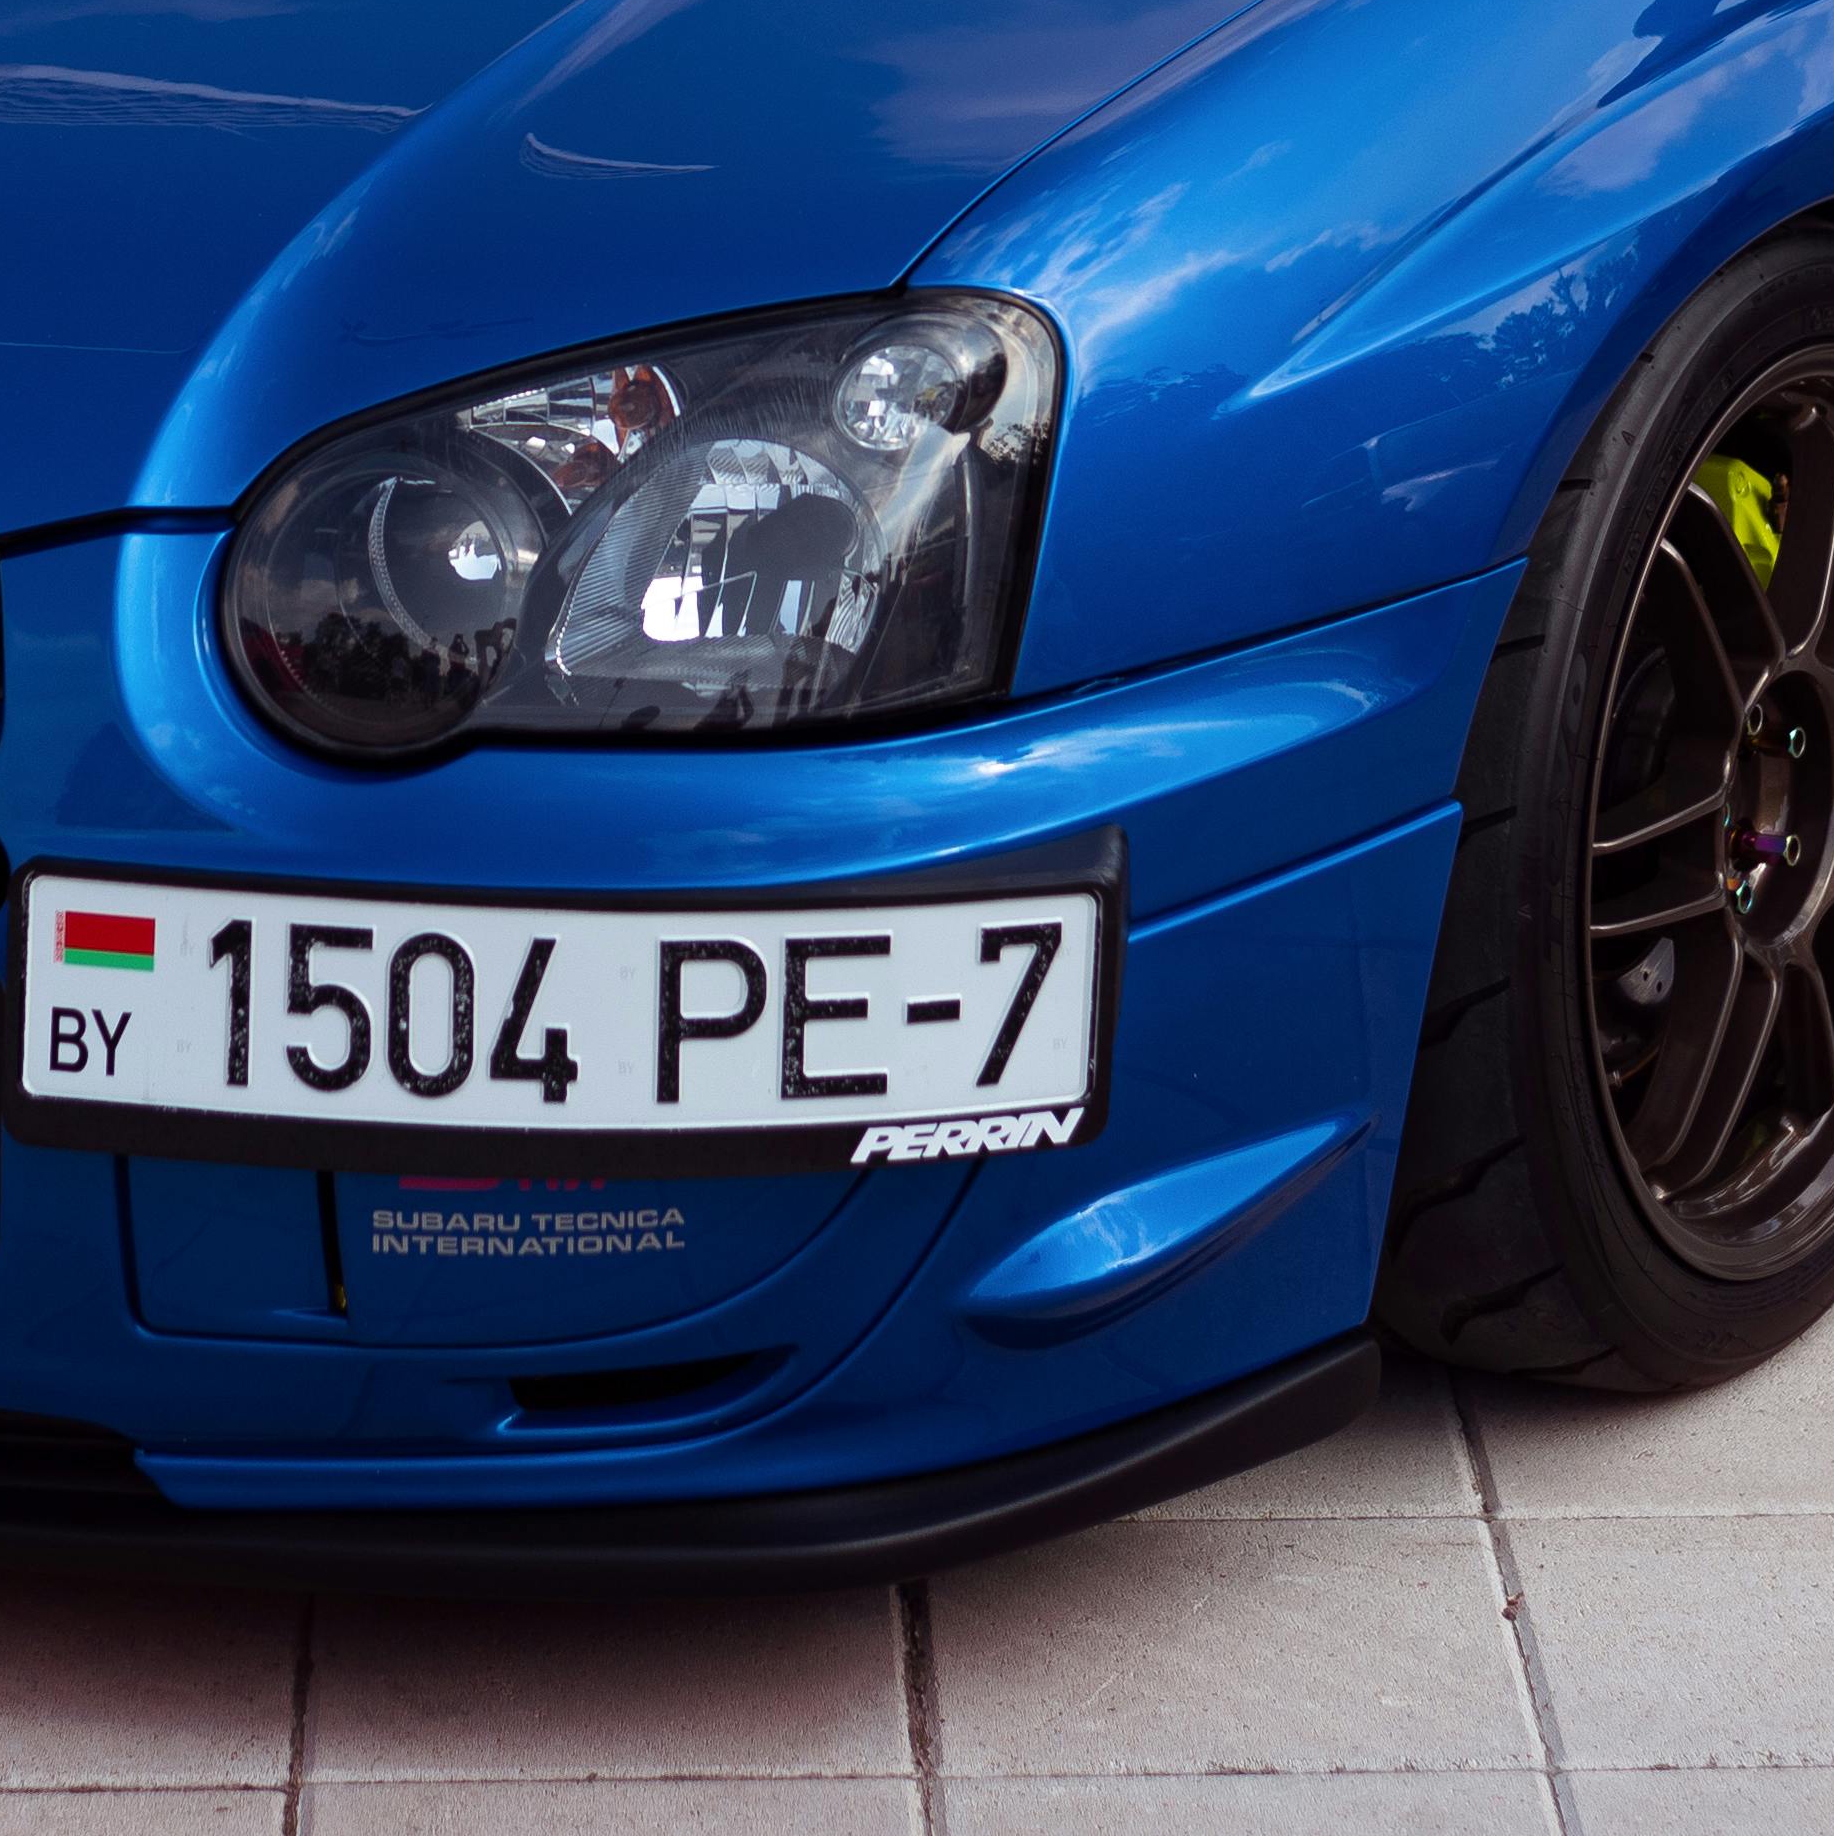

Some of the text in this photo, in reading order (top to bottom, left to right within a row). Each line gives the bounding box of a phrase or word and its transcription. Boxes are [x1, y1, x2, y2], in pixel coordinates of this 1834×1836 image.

[207, 919, 1063, 1104] 1504 PE-7
[49, 1005, 133, 1078] BY
[849, 1106, 1085, 1165] PERRIN
[372, 1207, 685, 1233] SUBARU TECNICA
[372, 1230, 685, 1256] INTERNATIONAL
